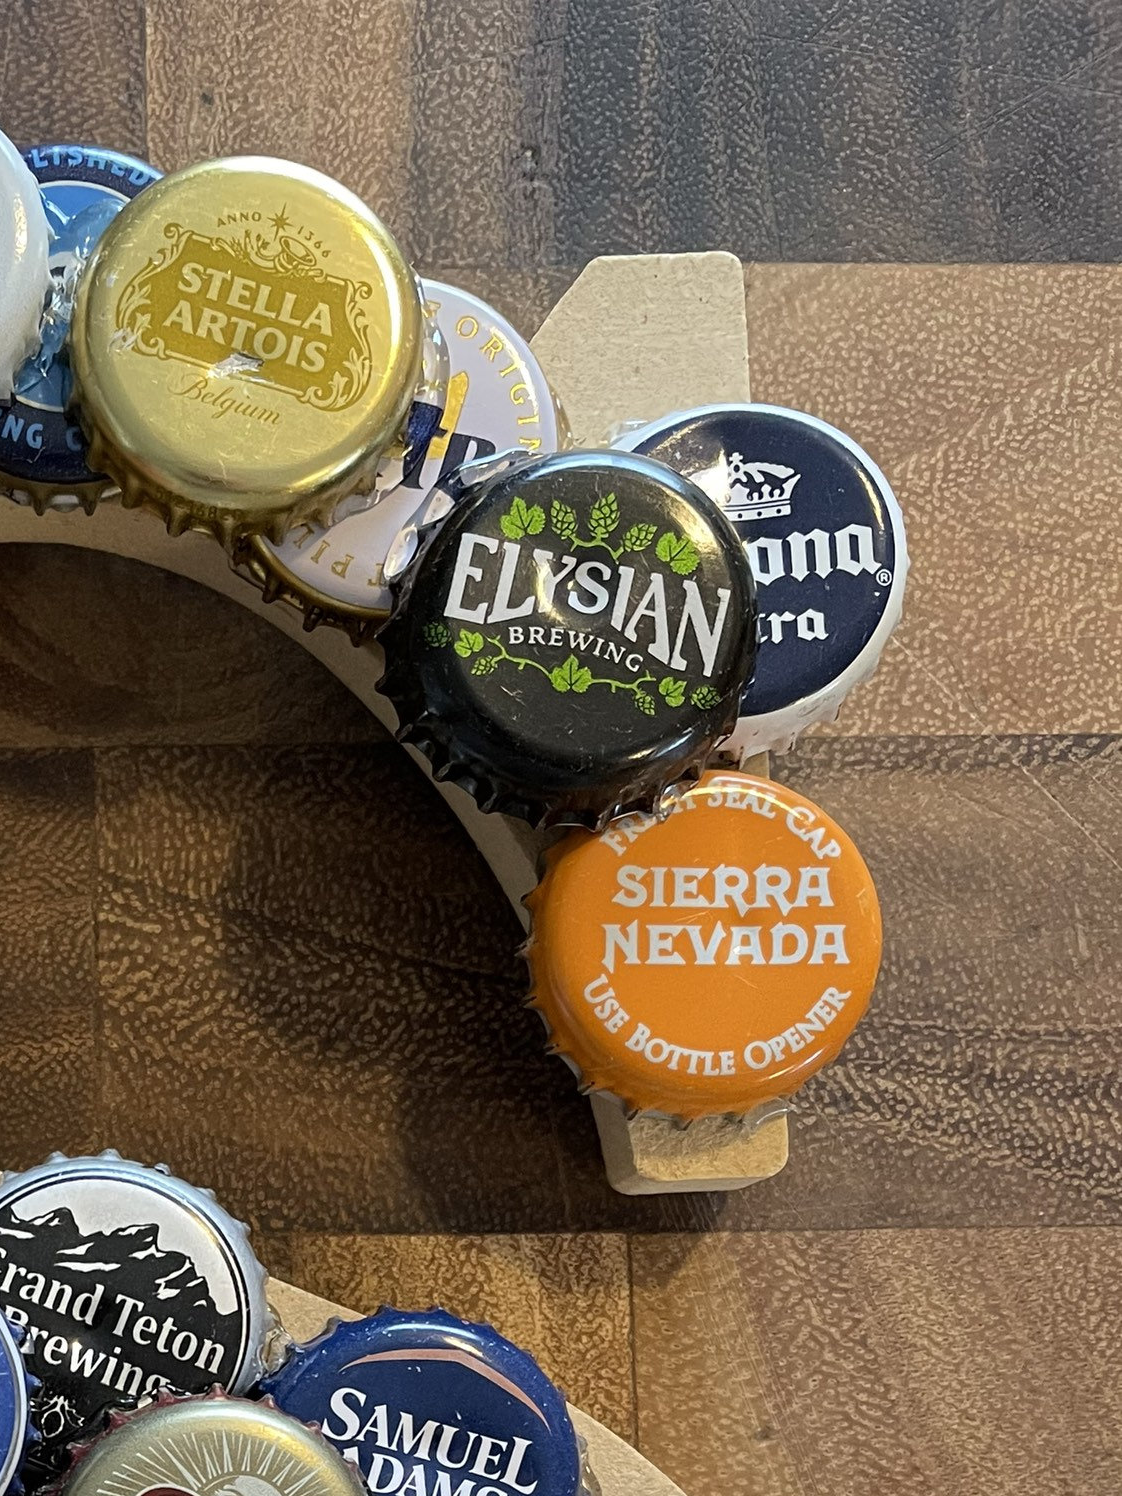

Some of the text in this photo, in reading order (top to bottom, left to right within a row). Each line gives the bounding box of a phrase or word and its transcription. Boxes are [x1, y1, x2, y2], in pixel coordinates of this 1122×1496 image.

[30, 146, 151, 185] LISHED
[216, 211, 332, 257] ANNO 1366
[178, 262, 333, 337] STELLA
[163, 301, 328, 373] ARTOIS
[168, 372, 282, 425] Belgium
[456, 315, 544, 454] ORIGIN
[443, 532, 731, 677] ELYSIAN
[508, 626, 644, 673] BREWING
[706, 787, 777, 820] SEAL
[786, 807, 842, 860] CAP
[611, 863, 835, 918] SIERRA
[601, 919, 851, 974] NEVADA
[583, 974, 853, 1077] USE BOTTLE OPENER
[116, 1294, 226, 1376] Teton
[322, 1387, 538, 1495] SAMUEL
